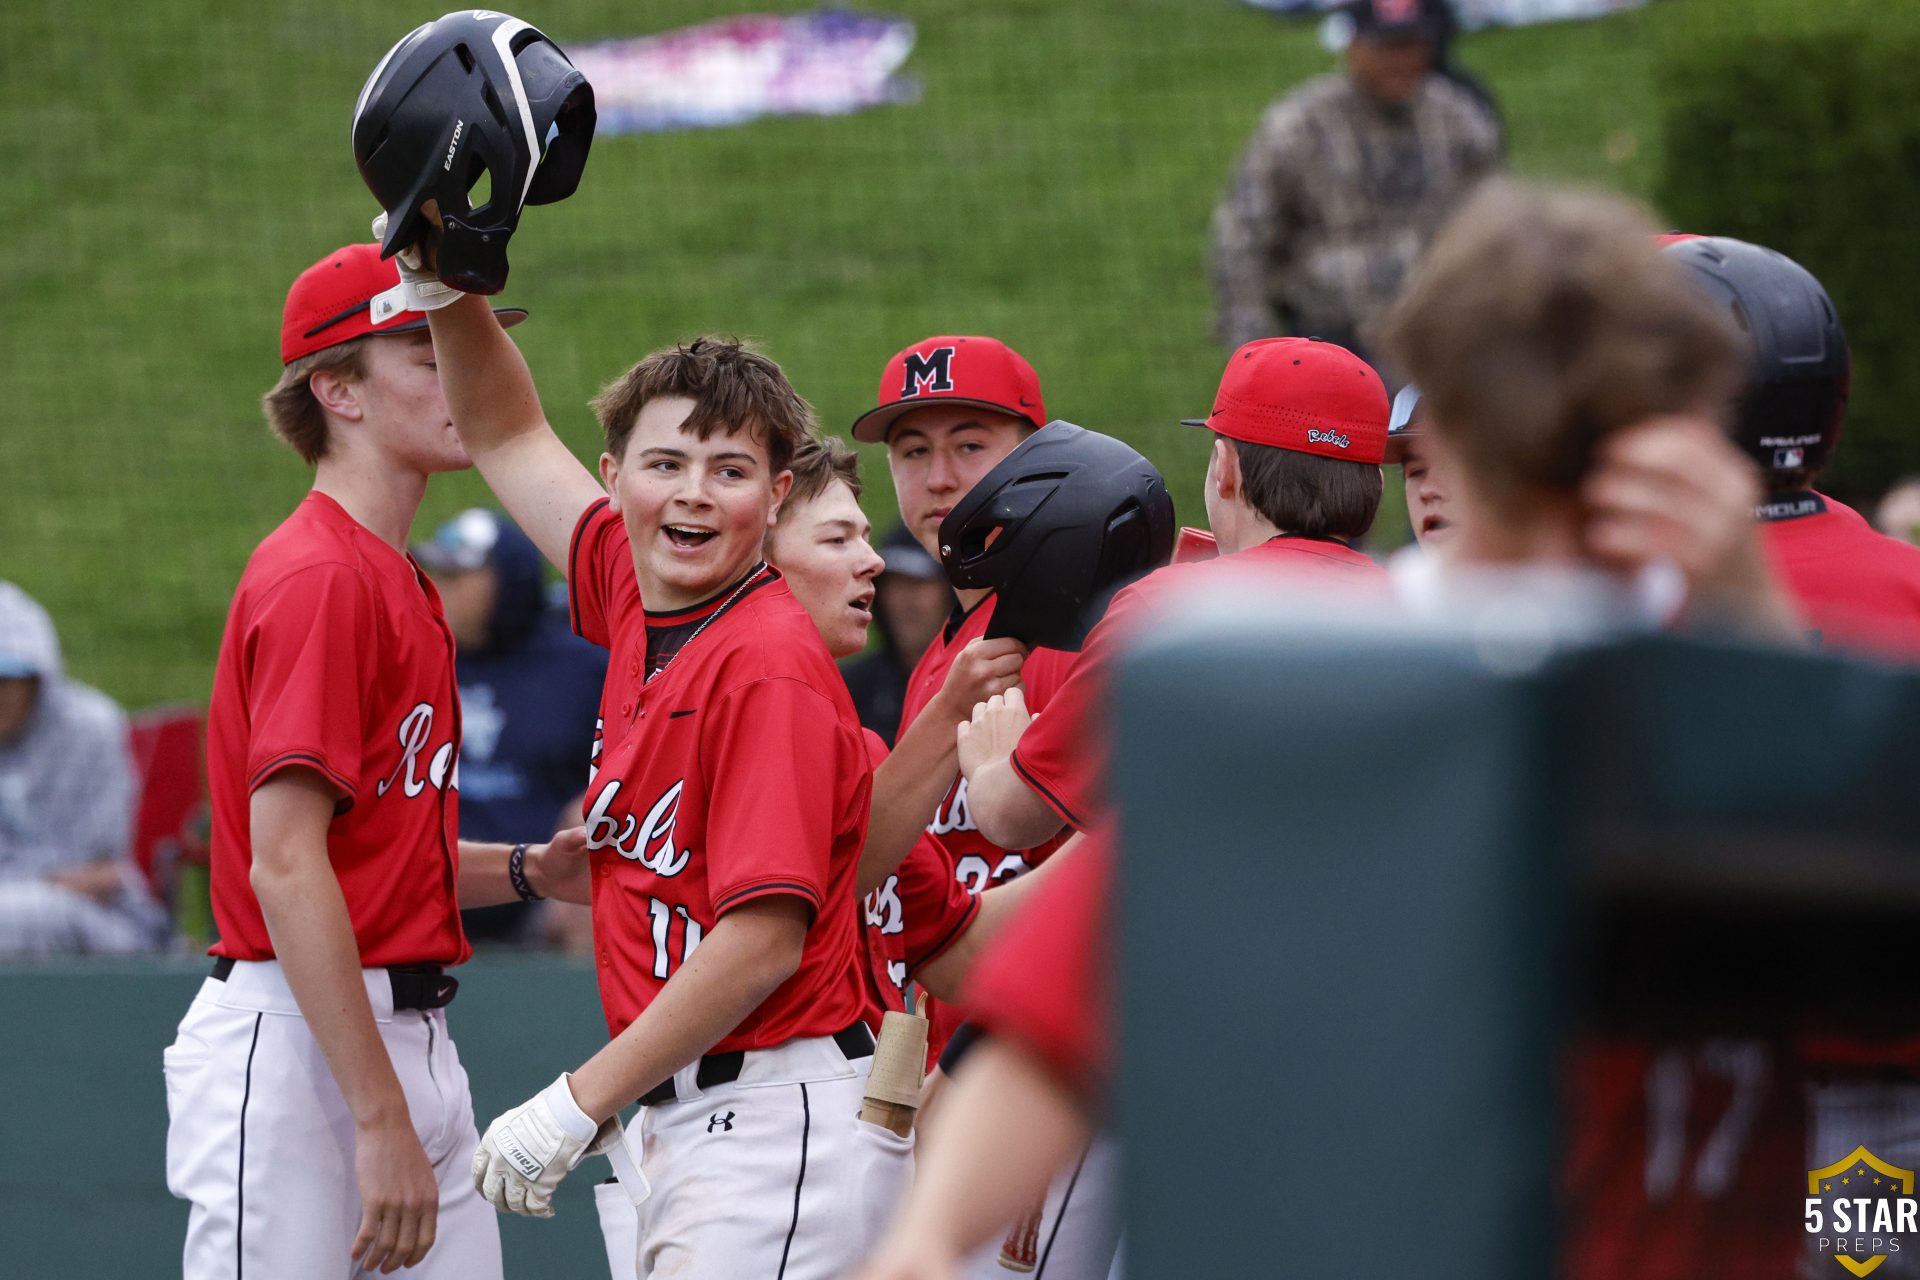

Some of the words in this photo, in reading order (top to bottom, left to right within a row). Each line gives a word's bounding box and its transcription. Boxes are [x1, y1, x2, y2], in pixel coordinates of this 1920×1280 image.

[444, 119, 464, 171] EASTON
[901, 346, 955, 400] M
[1307, 428, 1350, 449] Rebels
[647, 896, 703, 981] 11
